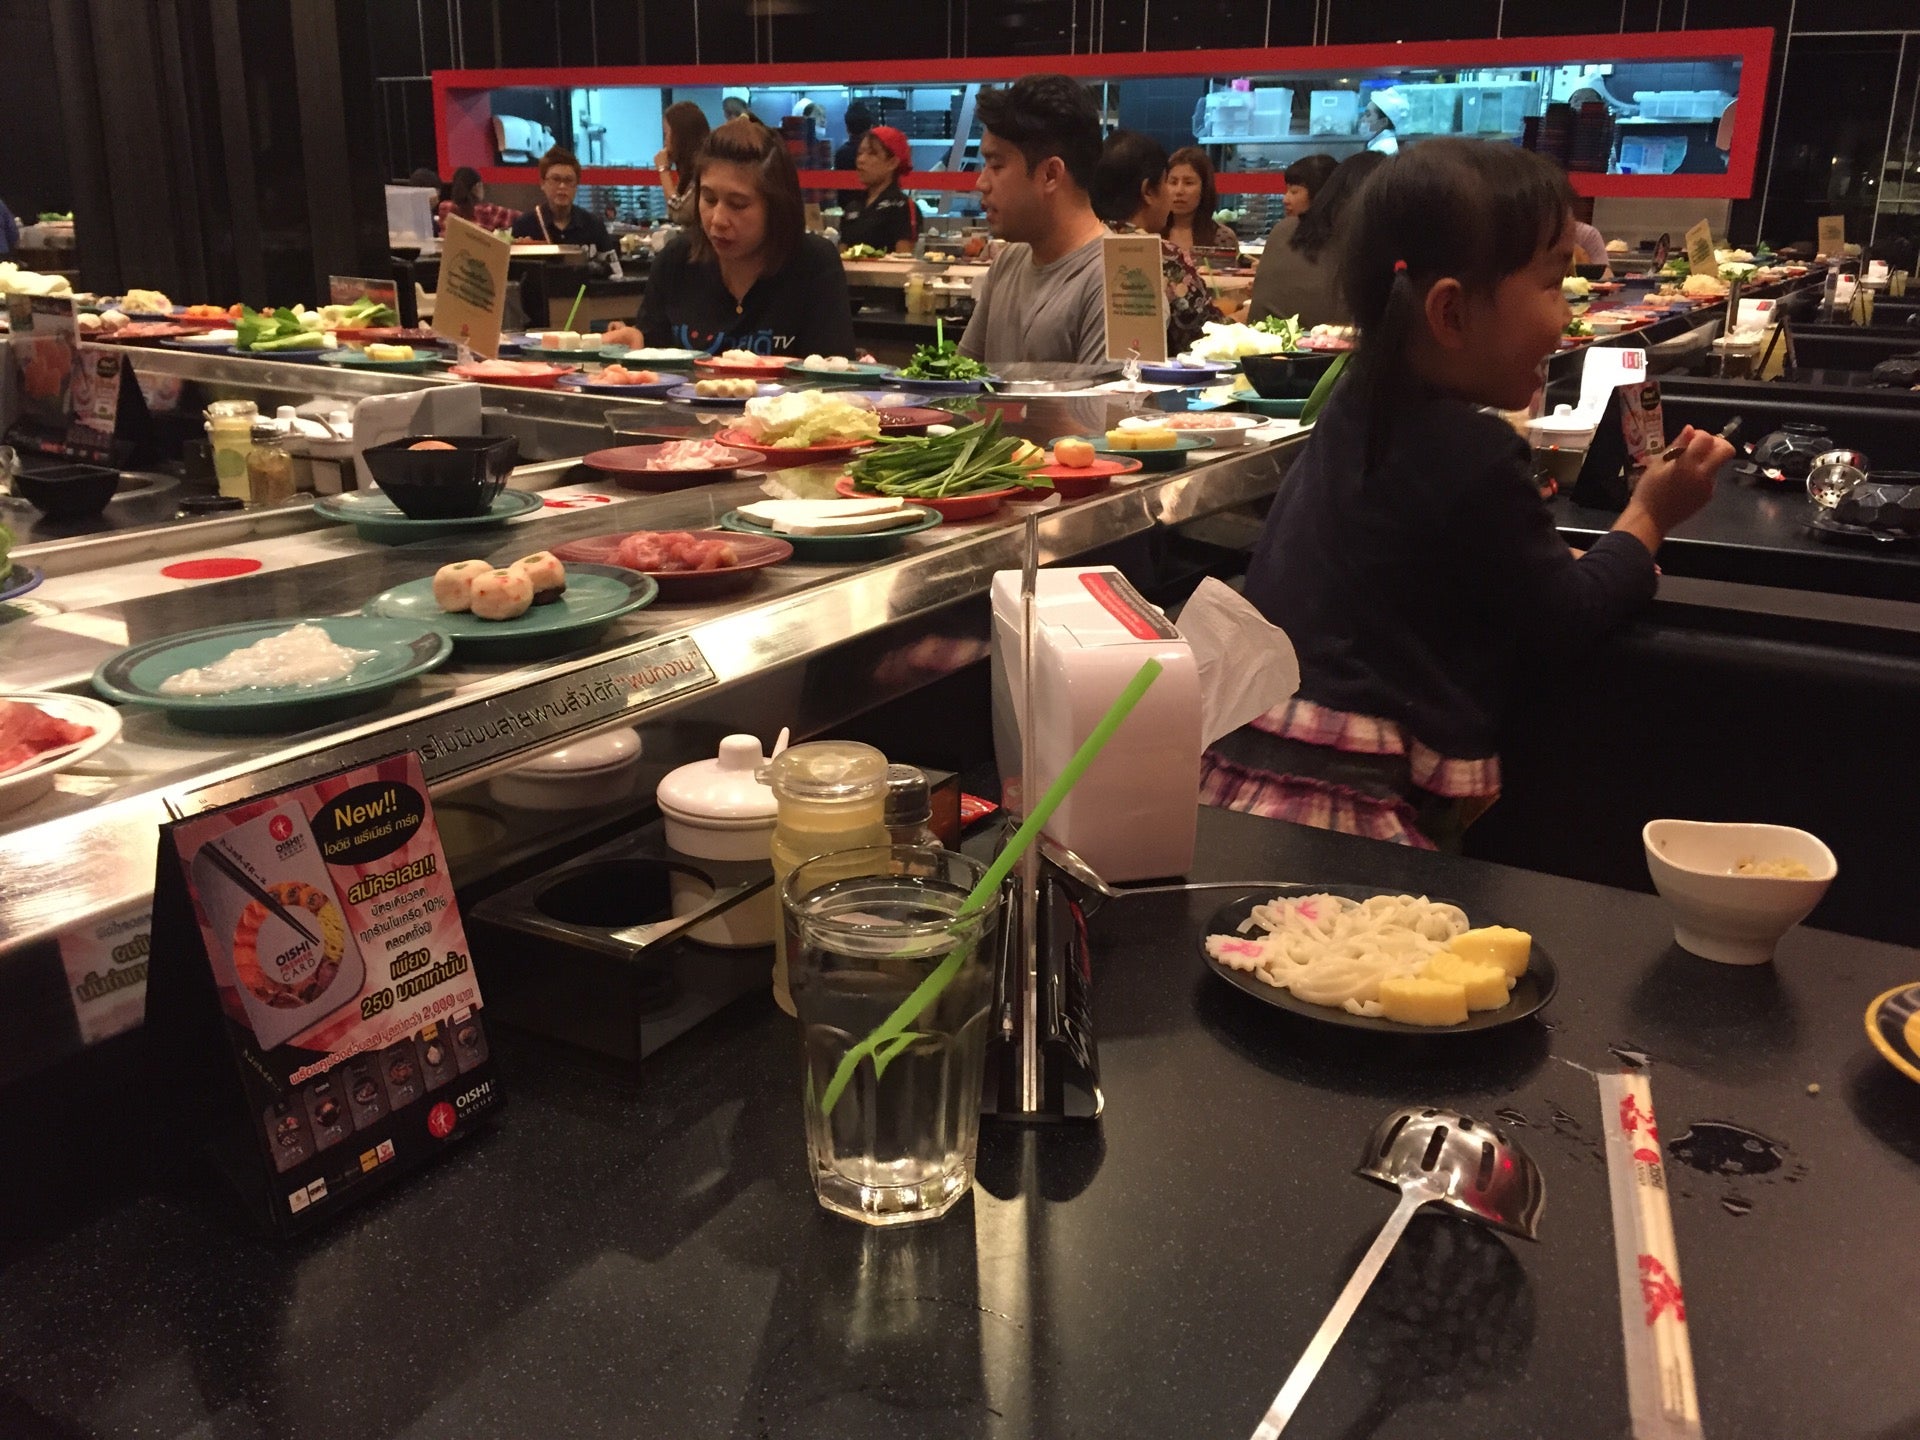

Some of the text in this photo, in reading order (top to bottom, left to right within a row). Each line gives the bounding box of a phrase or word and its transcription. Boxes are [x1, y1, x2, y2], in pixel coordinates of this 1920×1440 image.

[773, 335, 796, 350] TV
[334, 788, 398, 831] New!!
[275, 836, 301, 853] OISHI
[348, 853, 436, 906] สมัครเลย!!
[422, 896, 448, 916] 10%
[275, 940, 311, 967] OISHI
[390, 947, 431, 981] เพียง
[282, 957, 316, 983] CARD
[361, 950, 468, 1021] 250 บาทเท่านั้น
[422, 992, 456, 1019] 2,000
[455, 1081, 491, 1109] OISHI
